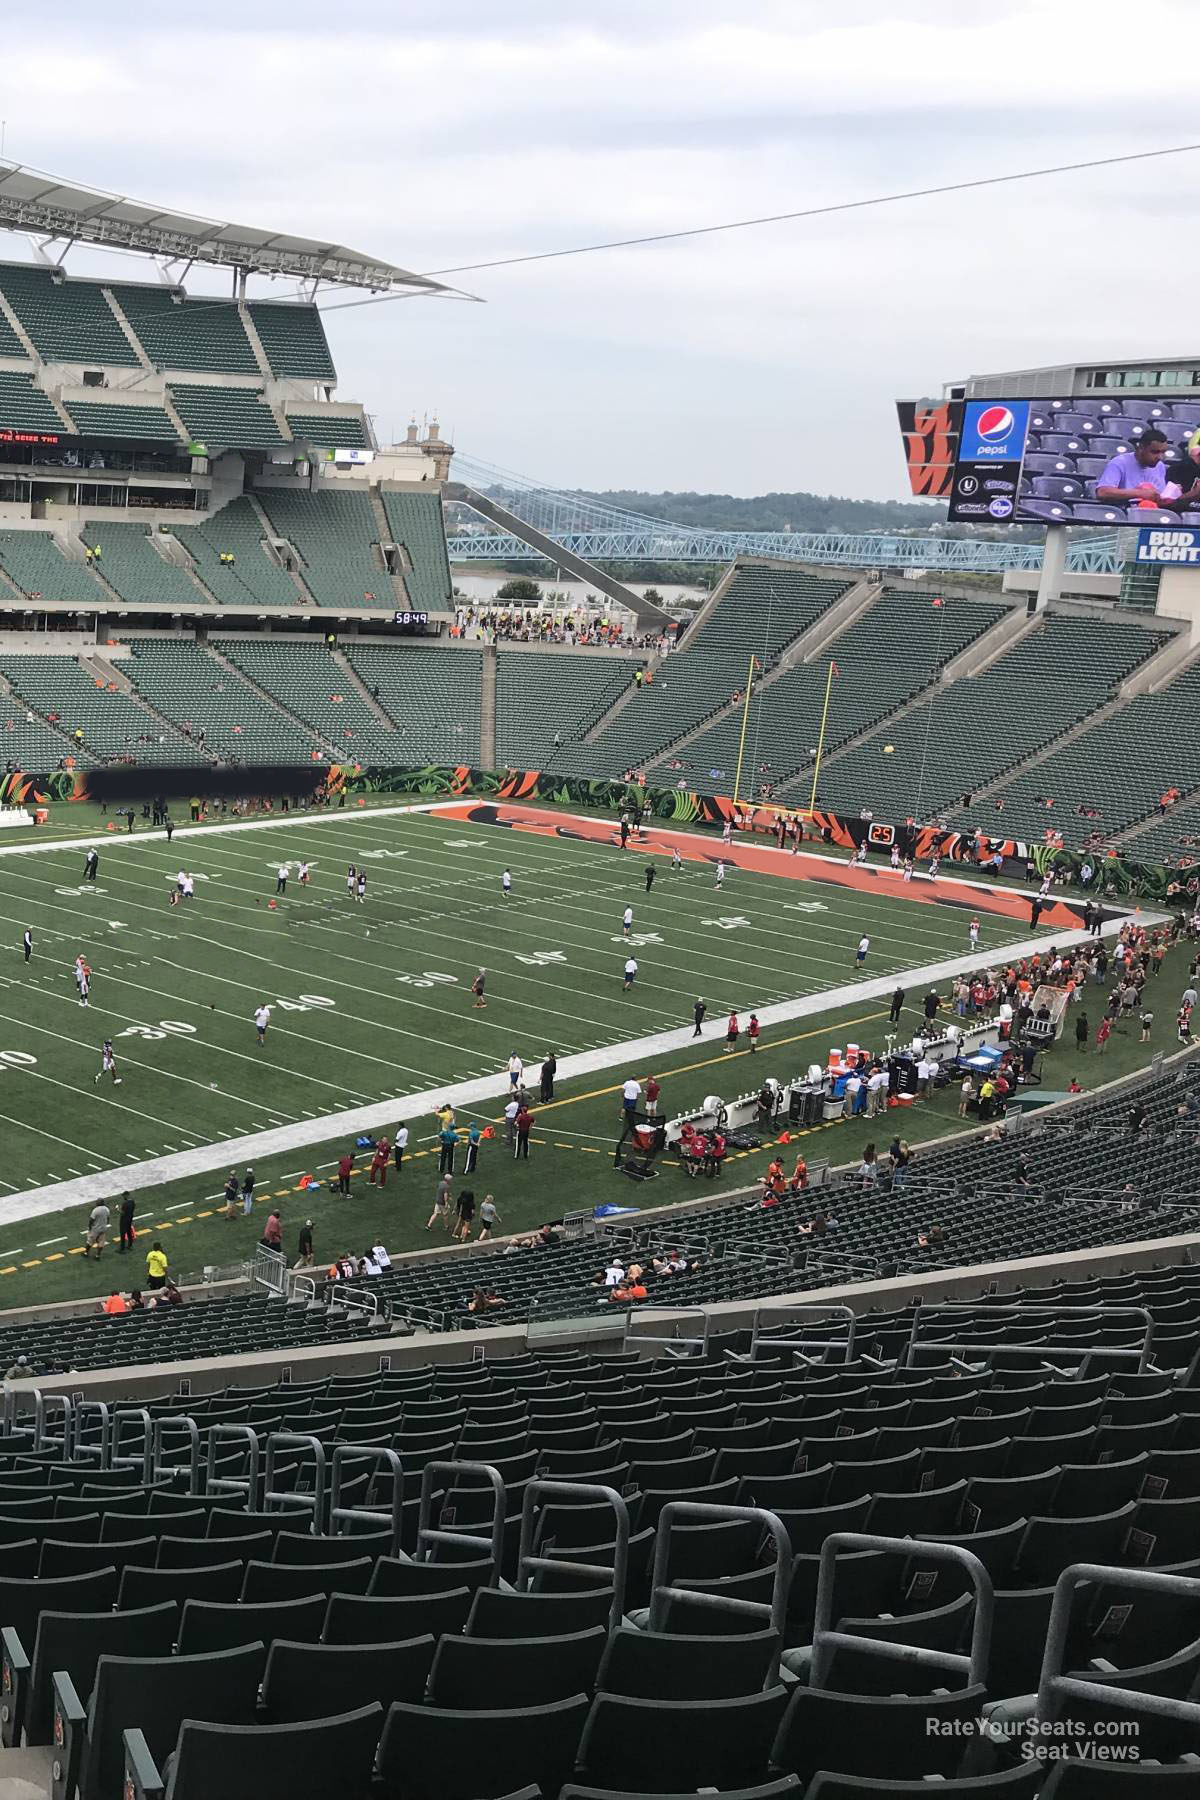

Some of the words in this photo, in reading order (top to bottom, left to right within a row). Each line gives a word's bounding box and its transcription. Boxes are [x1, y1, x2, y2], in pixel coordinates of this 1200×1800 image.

[977, 445, 1008, 456] pepsi
[1149, 531, 1194, 547] BUD
[1138, 546, 1200, 561] LIGHT
[396, 612, 427, 624] 58:49
[872, 826, 890, 841] 25
[394, 972, 459, 987] 50
[275, 994, 336, 1011] 40
[125, 1020, 197, 1039] 30
